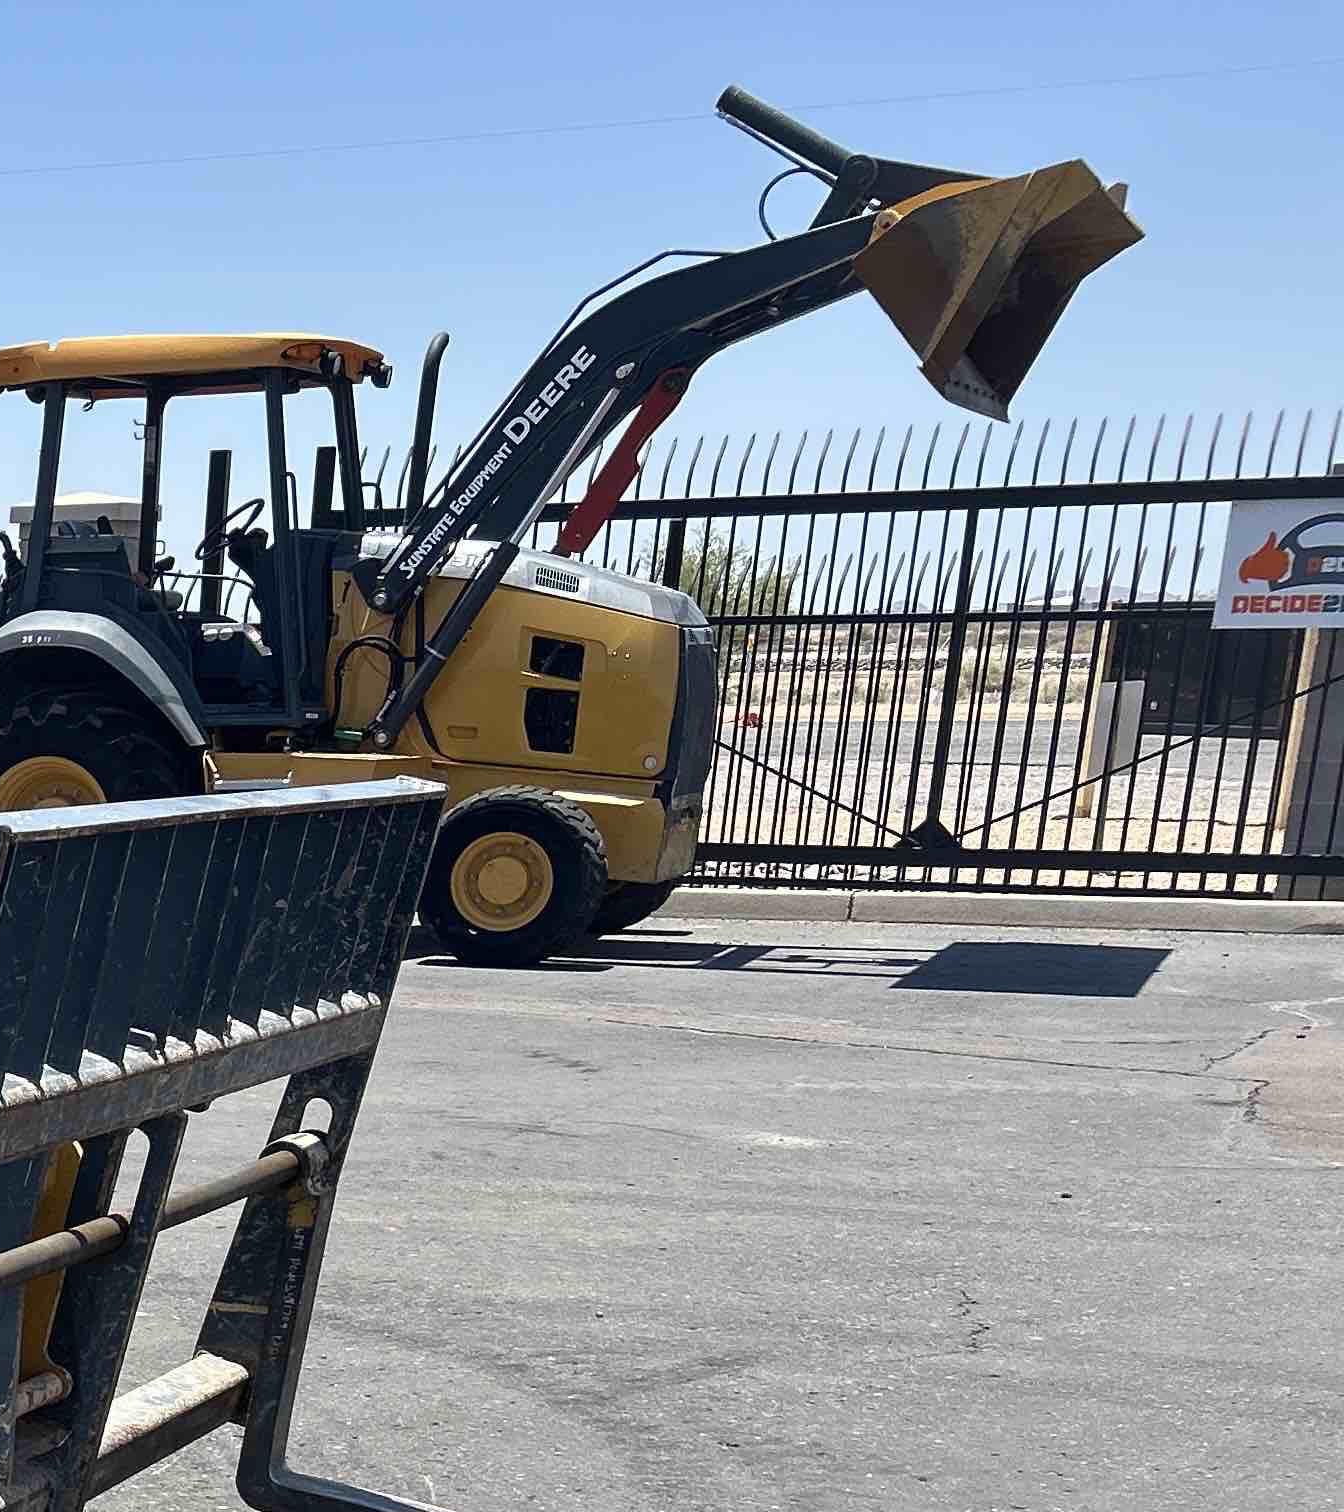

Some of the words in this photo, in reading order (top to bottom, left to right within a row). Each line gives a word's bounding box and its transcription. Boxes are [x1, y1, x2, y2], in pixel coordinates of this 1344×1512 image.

[502, 345, 597, 445] DEERE
[399, 512, 456, 580] SUNSTATE
[449, 441, 513, 516] EQUIPMENT
[1231, 594, 1344, 614] DECIDE2
